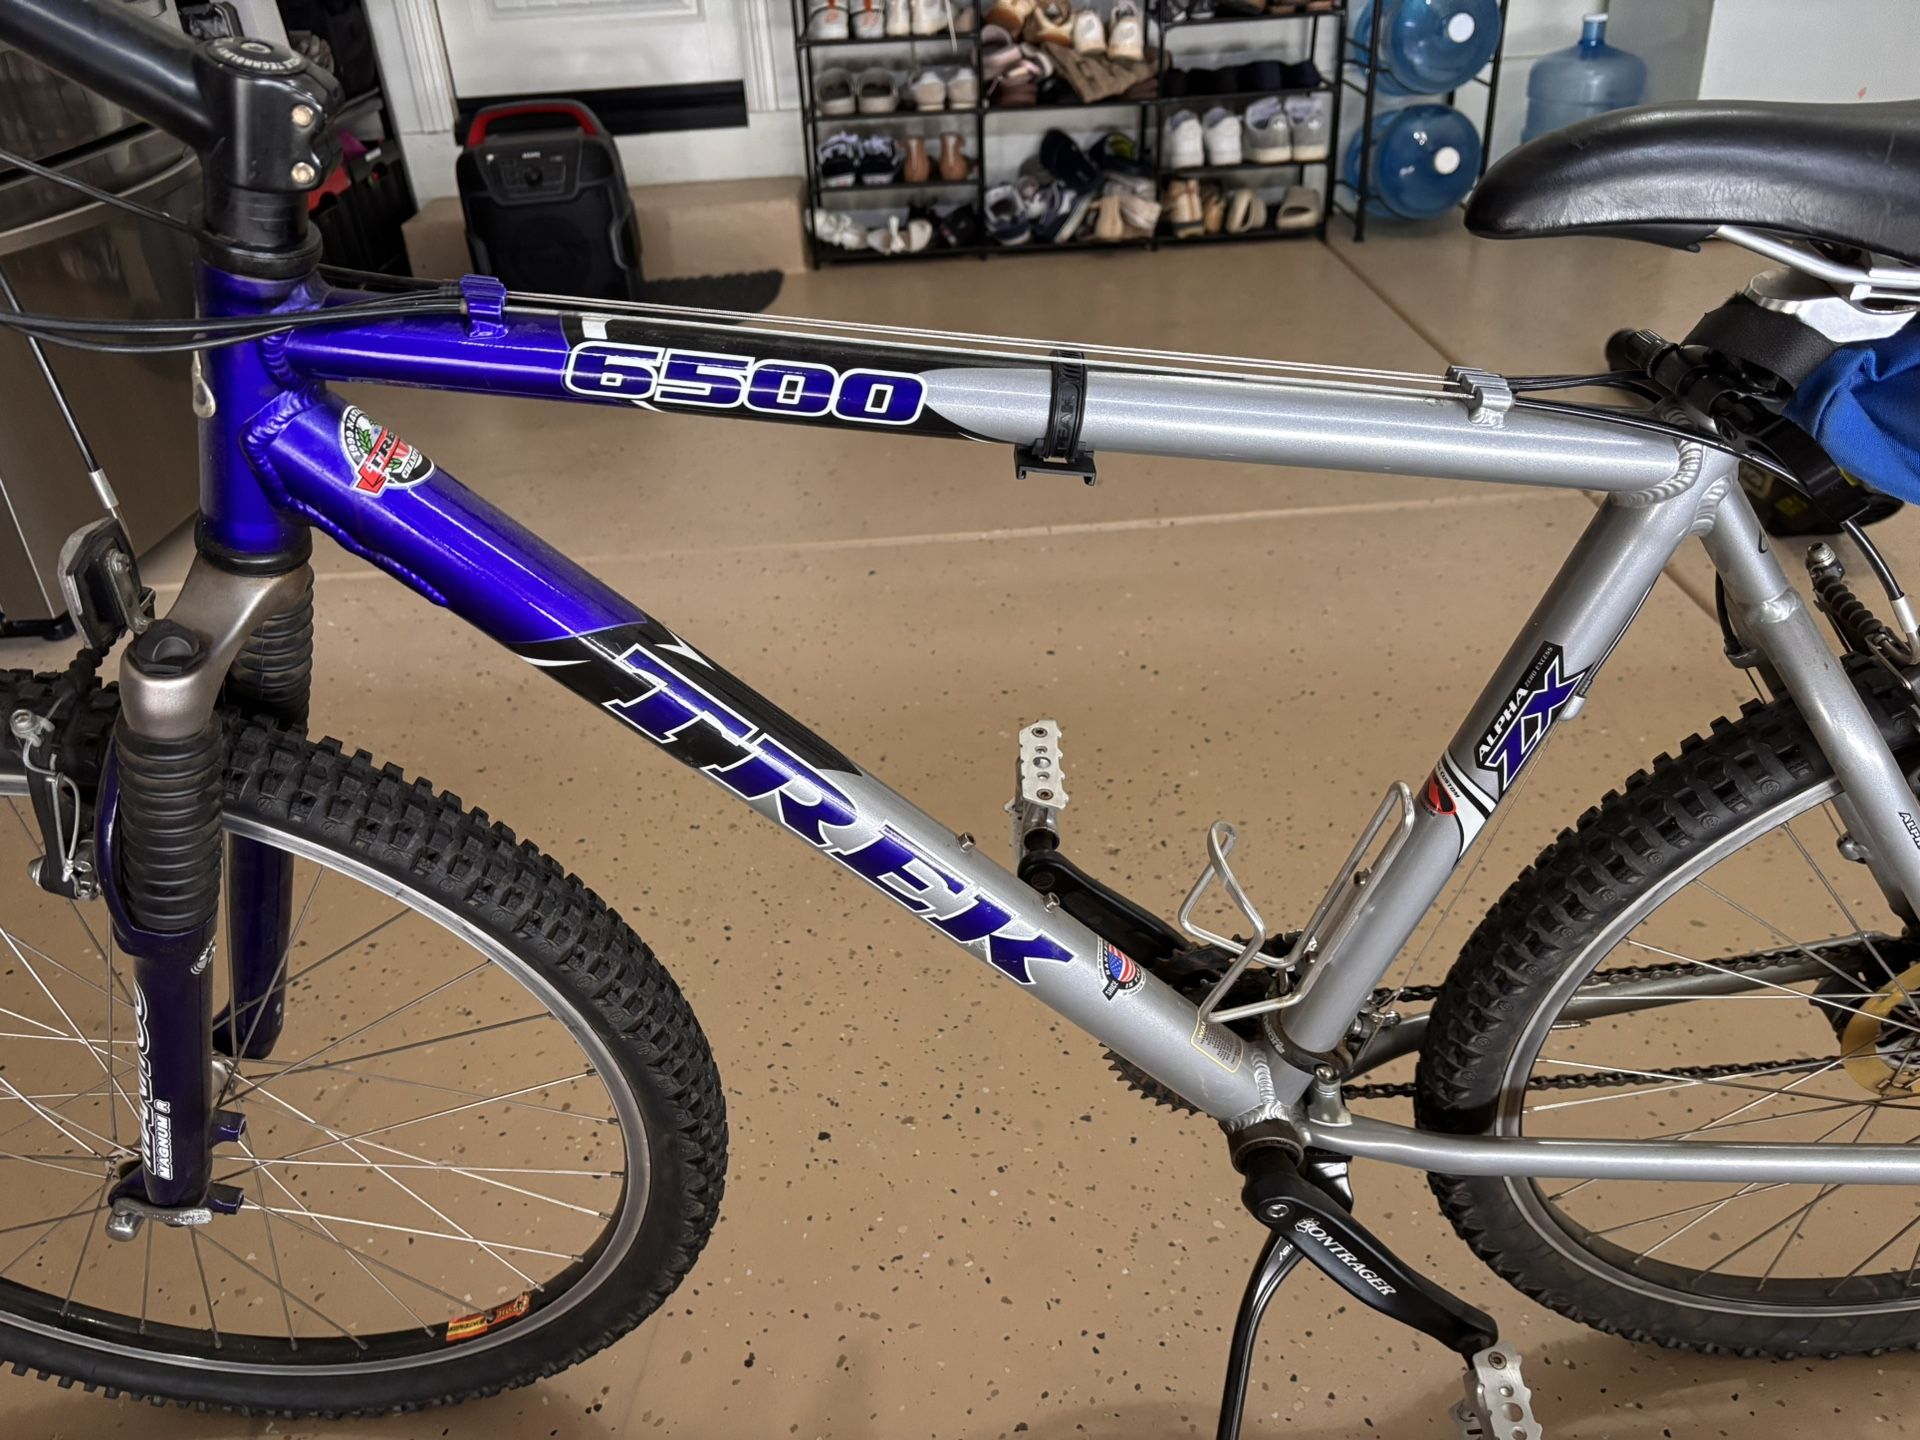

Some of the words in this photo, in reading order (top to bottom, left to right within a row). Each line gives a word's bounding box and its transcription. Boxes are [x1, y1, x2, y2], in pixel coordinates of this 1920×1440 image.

[564, 340, 929, 426] 6500
[345, 430, 362, 458] 1999
[1478, 686, 1529, 763] ALPHA
[1535, 646, 1554, 671] EXCESS
[1484, 654, 1587, 792] ZX
[601, 643, 1078, 985] TREK
[154, 1099, 171, 1114] R
[156, 1115, 173, 1181] MAGNUM
[1294, 1217, 1397, 1297] BONTRAGER
